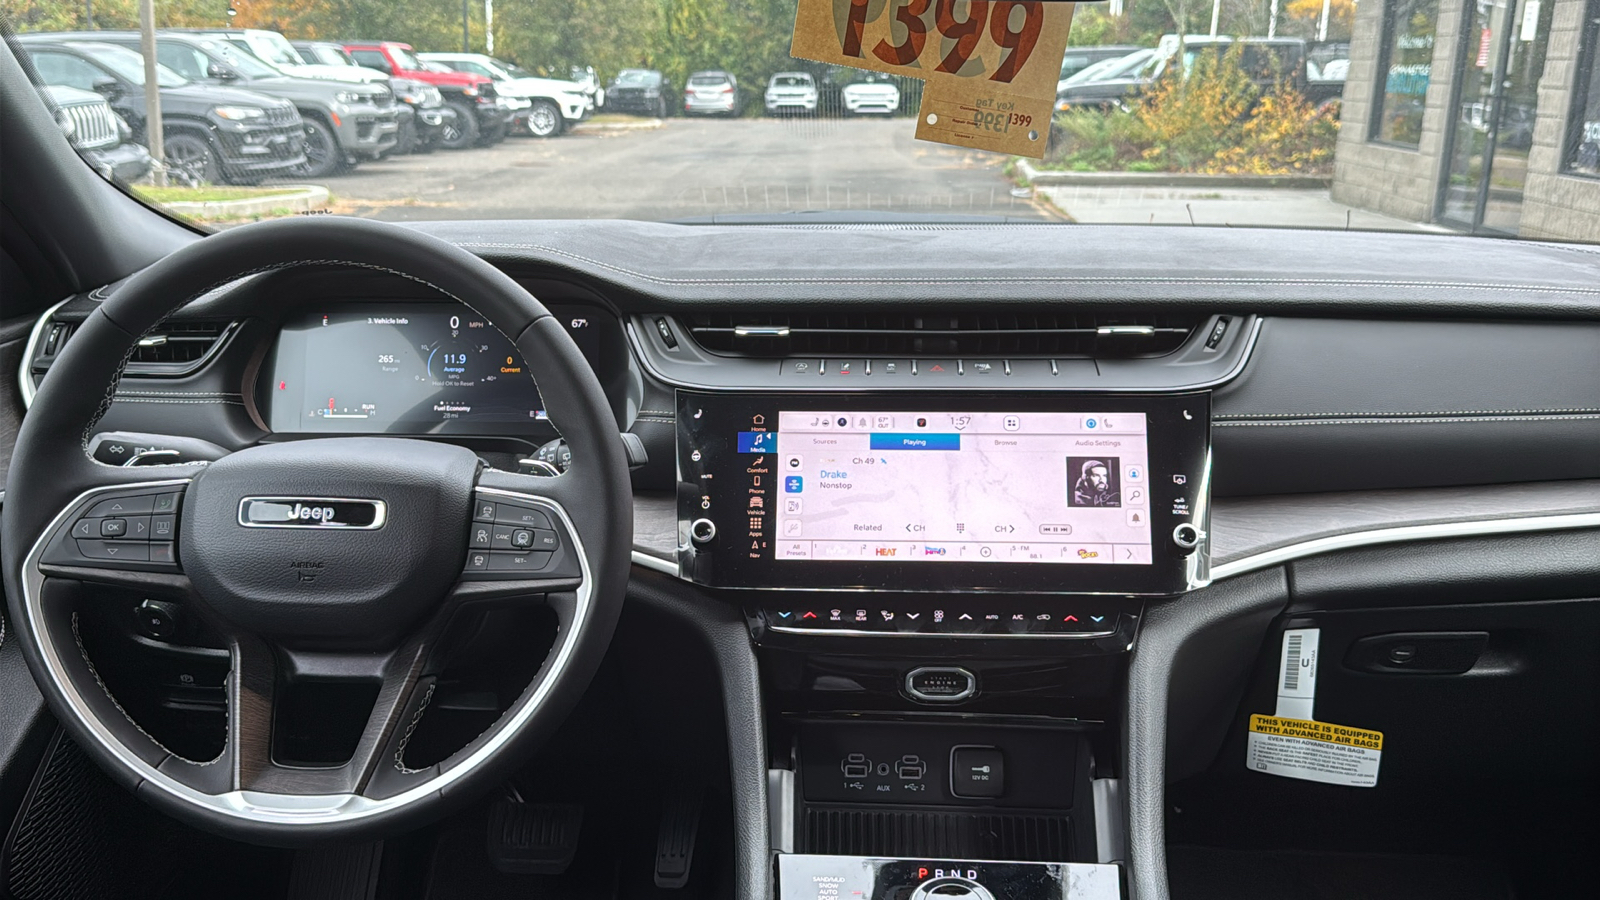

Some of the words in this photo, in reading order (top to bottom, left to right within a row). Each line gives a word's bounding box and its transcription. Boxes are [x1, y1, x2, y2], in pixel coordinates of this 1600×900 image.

[1008, 113, 1032, 127] 1399
[450, 316, 459, 328] 0
[378, 355, 394, 364] 265
[444, 354, 466, 364] 11.9
[506, 356, 513, 365] 0
[950, 416, 971, 425] 1:57
[820, 470, 847, 478] Drake
[288, 503, 335, 522] Jeep
[875, 548, 897, 556] HEAT
[1257, 718, 1278, 726] THIS
[1280, 720, 1319, 732] VEHICLE
[1334, 728, 1380, 741] EQUIPPED
[1256, 724, 1280, 733] WITH
[1282, 727, 1332, 741] ADVANCED
[1354, 739, 1379, 748] BAGS
[1302, 740, 1334, 750] ADVANCED
[919, 868, 928, 879] P
[935, 869, 944, 878] R
[951, 869, 960, 878] N
[967, 870, 977, 880] D
